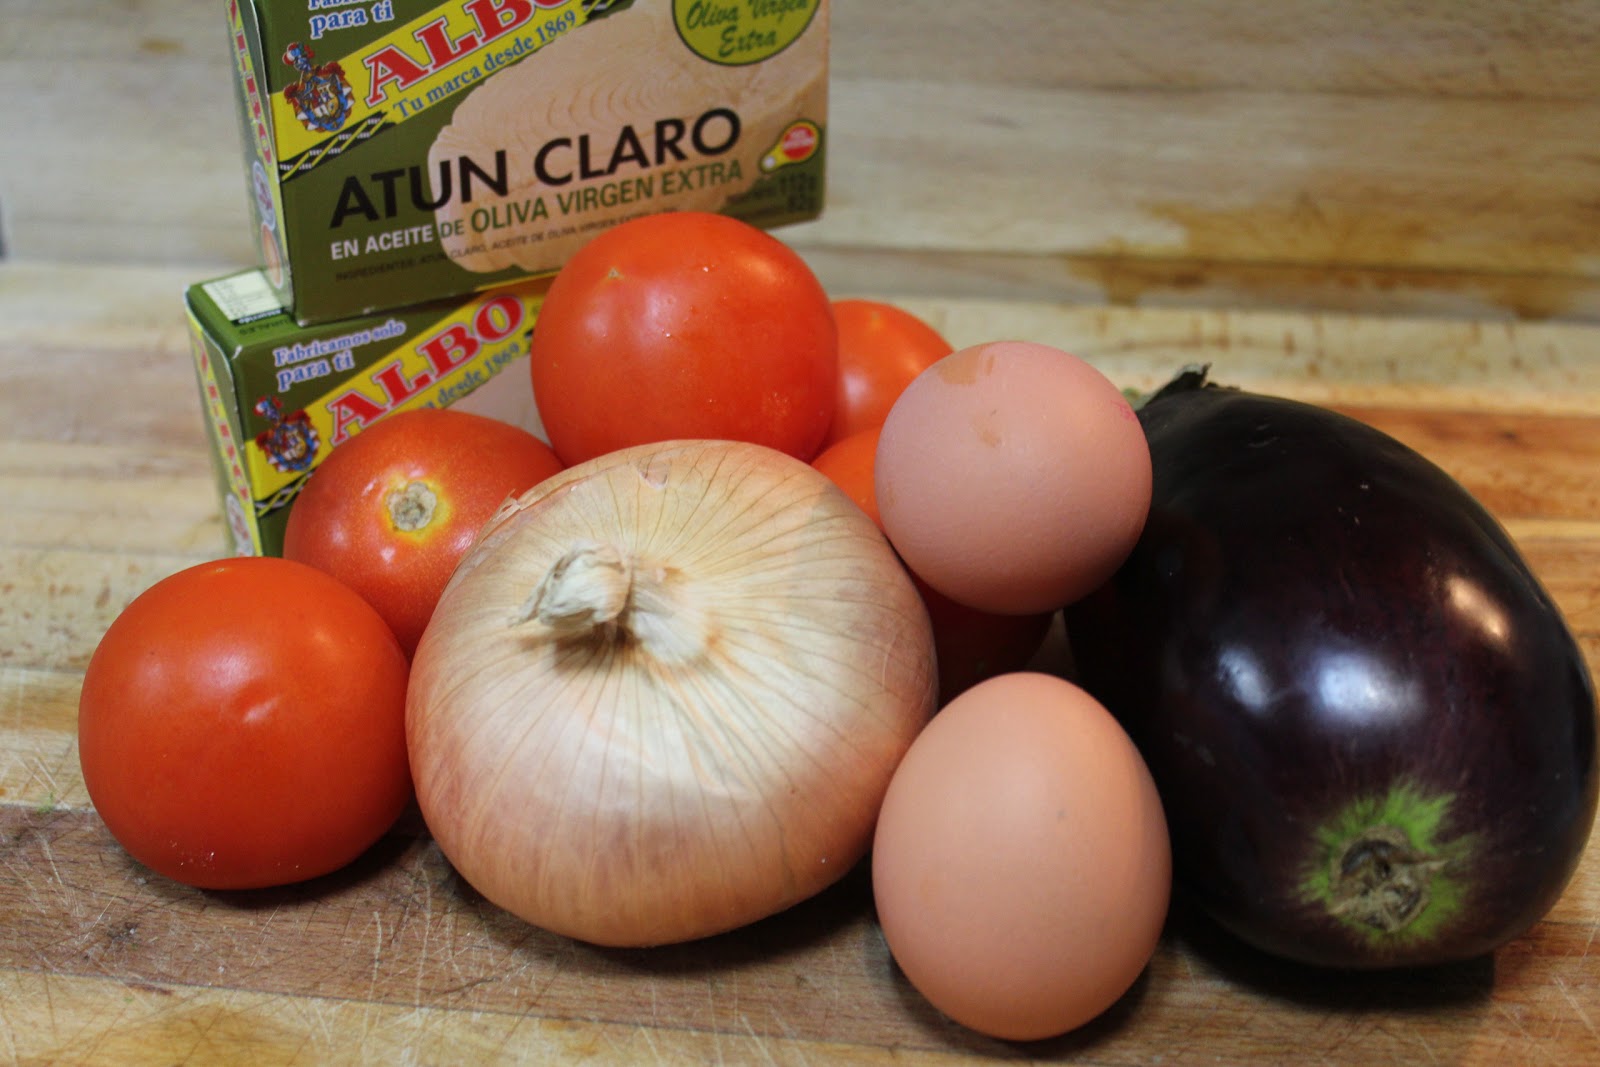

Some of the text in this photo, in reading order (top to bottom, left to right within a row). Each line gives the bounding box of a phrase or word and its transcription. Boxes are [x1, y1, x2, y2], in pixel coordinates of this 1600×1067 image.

[311, 1, 394, 38] para ti
[361, 0, 577, 109] ALB
[393, 10, 577, 118] Tu marca desde 1869
[686, 0, 738, 30] Oliva
[329, 147, 509, 228] ATUN
[533, 106, 742, 187] CLARO
[330, 238, 360, 260] EN
[365, 223, 434, 254] ACEITE
[440, 219, 465, 238] DE
[471, 196, 549, 233] OLIVA
[556, 174, 654, 216] VIRGEN
[661, 159, 743, 197] EXTRA
[273, 318, 407, 367] Fabricamos solo
[276, 349, 355, 393] para ti
[328, 295, 525, 446] ALBO
